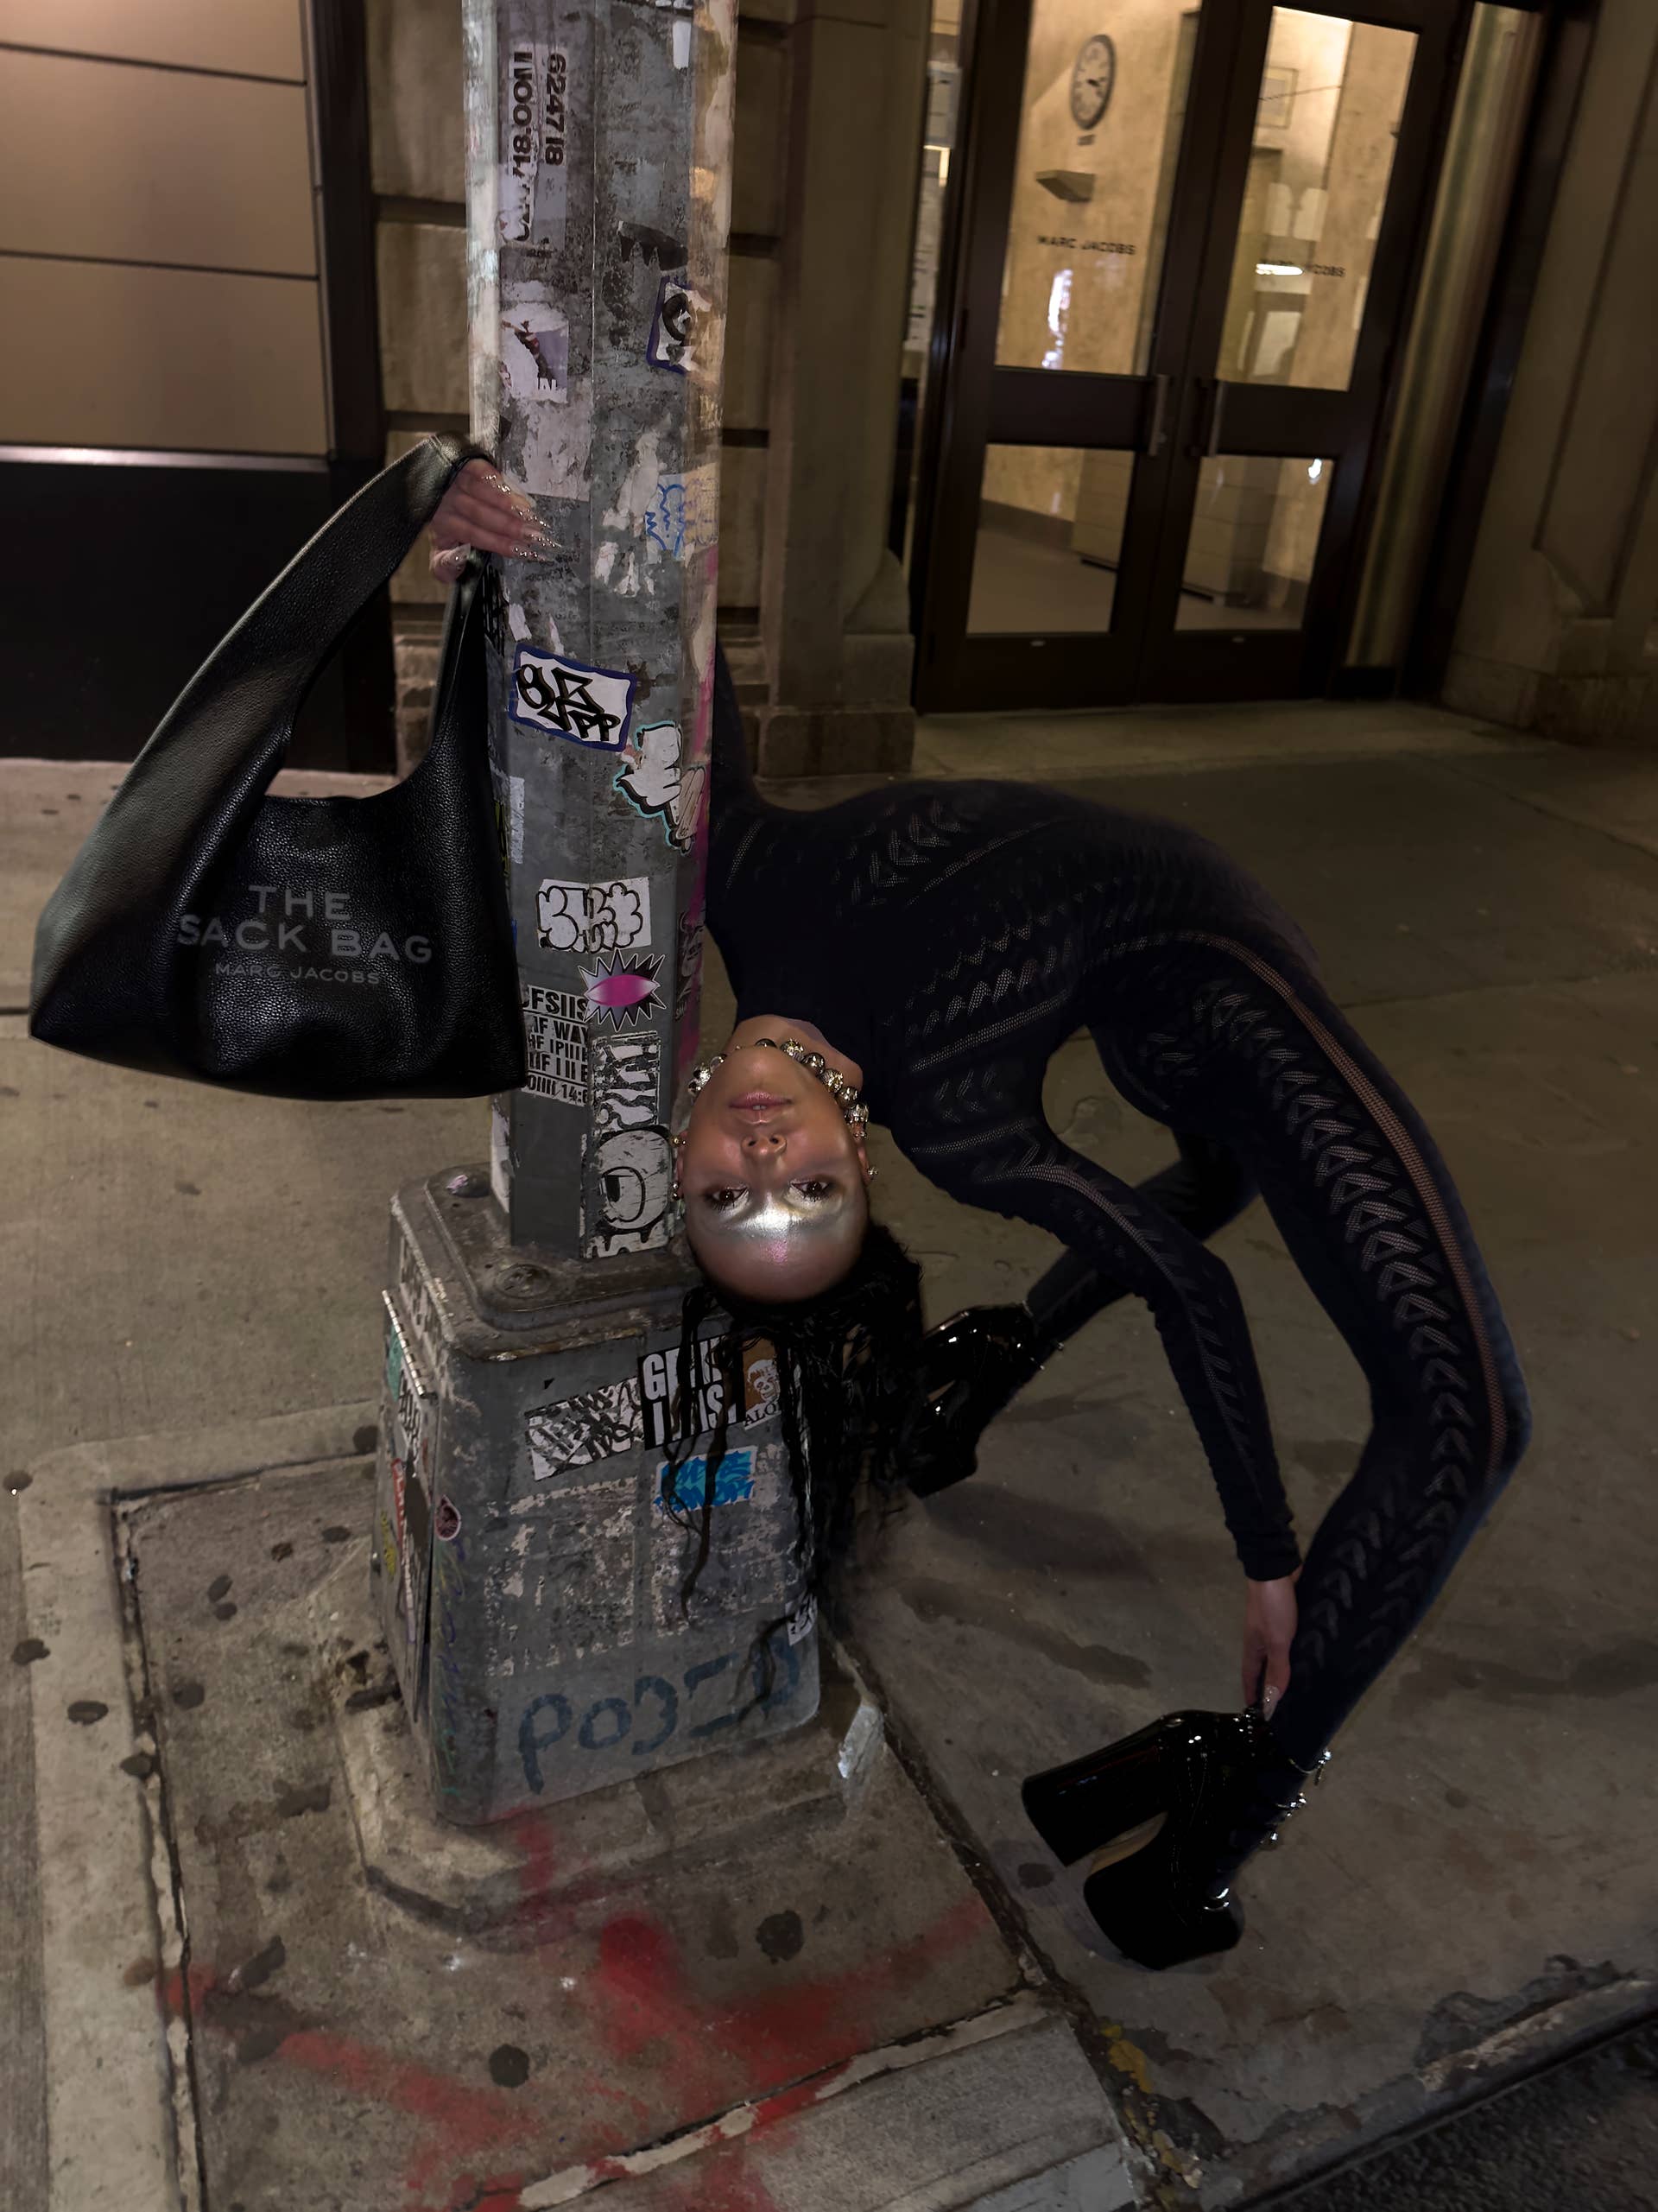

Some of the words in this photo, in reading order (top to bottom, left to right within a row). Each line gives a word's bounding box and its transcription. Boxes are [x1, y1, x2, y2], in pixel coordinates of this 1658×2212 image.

[545, 53, 566, 165] 624718
[1082, 241, 1136, 256] JACOBS
[248, 884, 351, 922] THE
[177, 913, 307, 953] SACK
[330, 929, 433, 964] BAG
[215, 963, 282, 978] MARC
[290, 967, 381, 985] JACOBS
